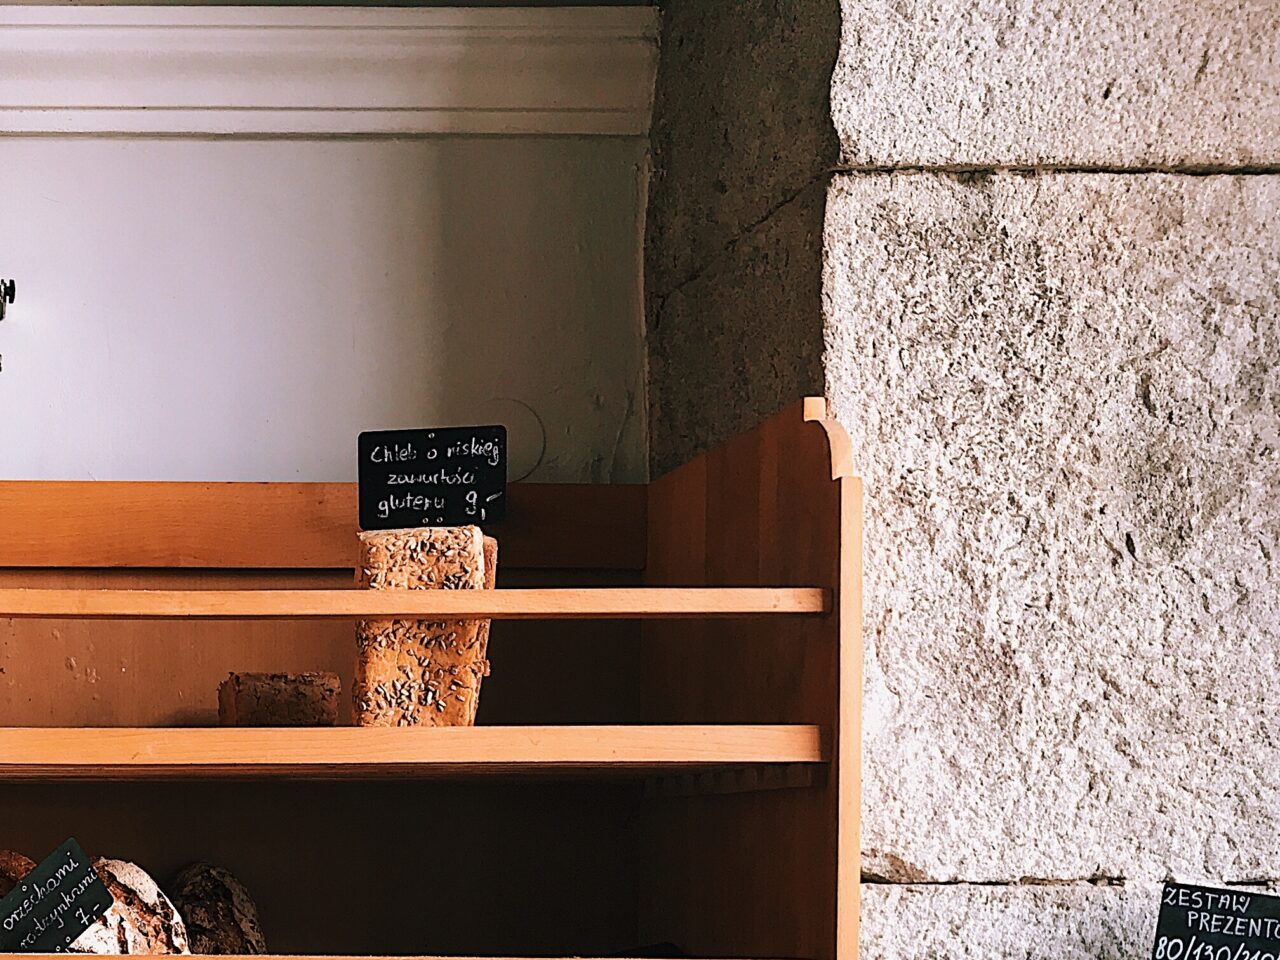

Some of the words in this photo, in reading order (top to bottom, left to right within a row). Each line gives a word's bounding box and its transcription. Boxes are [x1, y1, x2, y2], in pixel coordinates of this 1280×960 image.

[370, 443, 417, 463] Chleb
[427, 448, 438, 460] o
[3, 852, 80, 931] orzechami
[1163, 887, 1251, 914] ZESTAW
